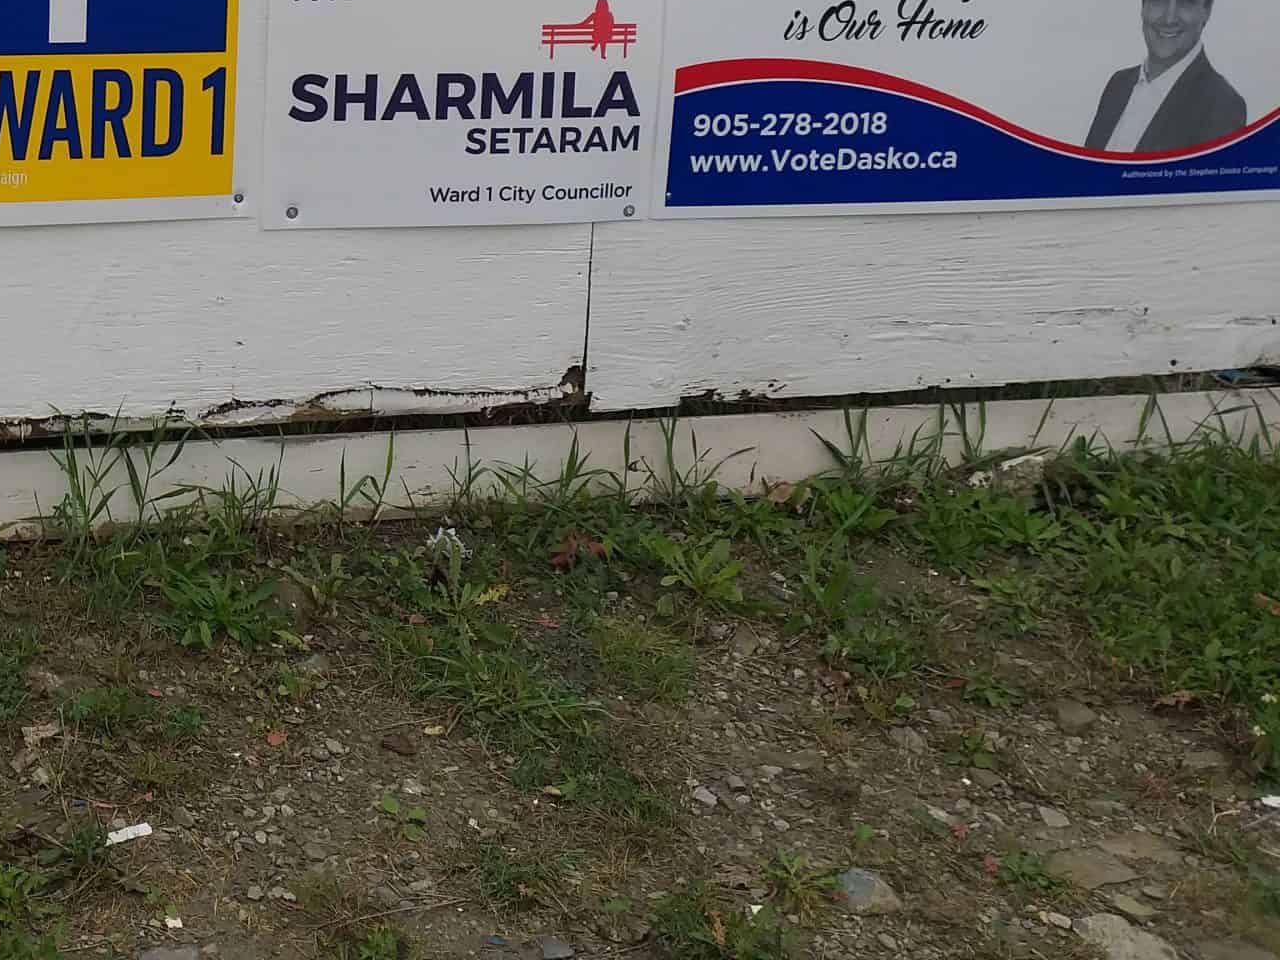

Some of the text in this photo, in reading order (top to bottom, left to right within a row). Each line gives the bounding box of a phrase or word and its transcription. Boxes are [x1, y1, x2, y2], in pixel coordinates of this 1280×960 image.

[783, 10, 815, 40] is
[818, 0, 887, 41] Our
[200, 66, 226, 156] 1
[287, 70, 641, 123] SHARMILA
[693, 112, 888, 137] 905-278-2018
[465, 125, 640, 155] SETARAM
[690, 147, 958, 173] www.VoteDasko.ca
[429, 183, 632, 205] Ward 1 City Councillor
